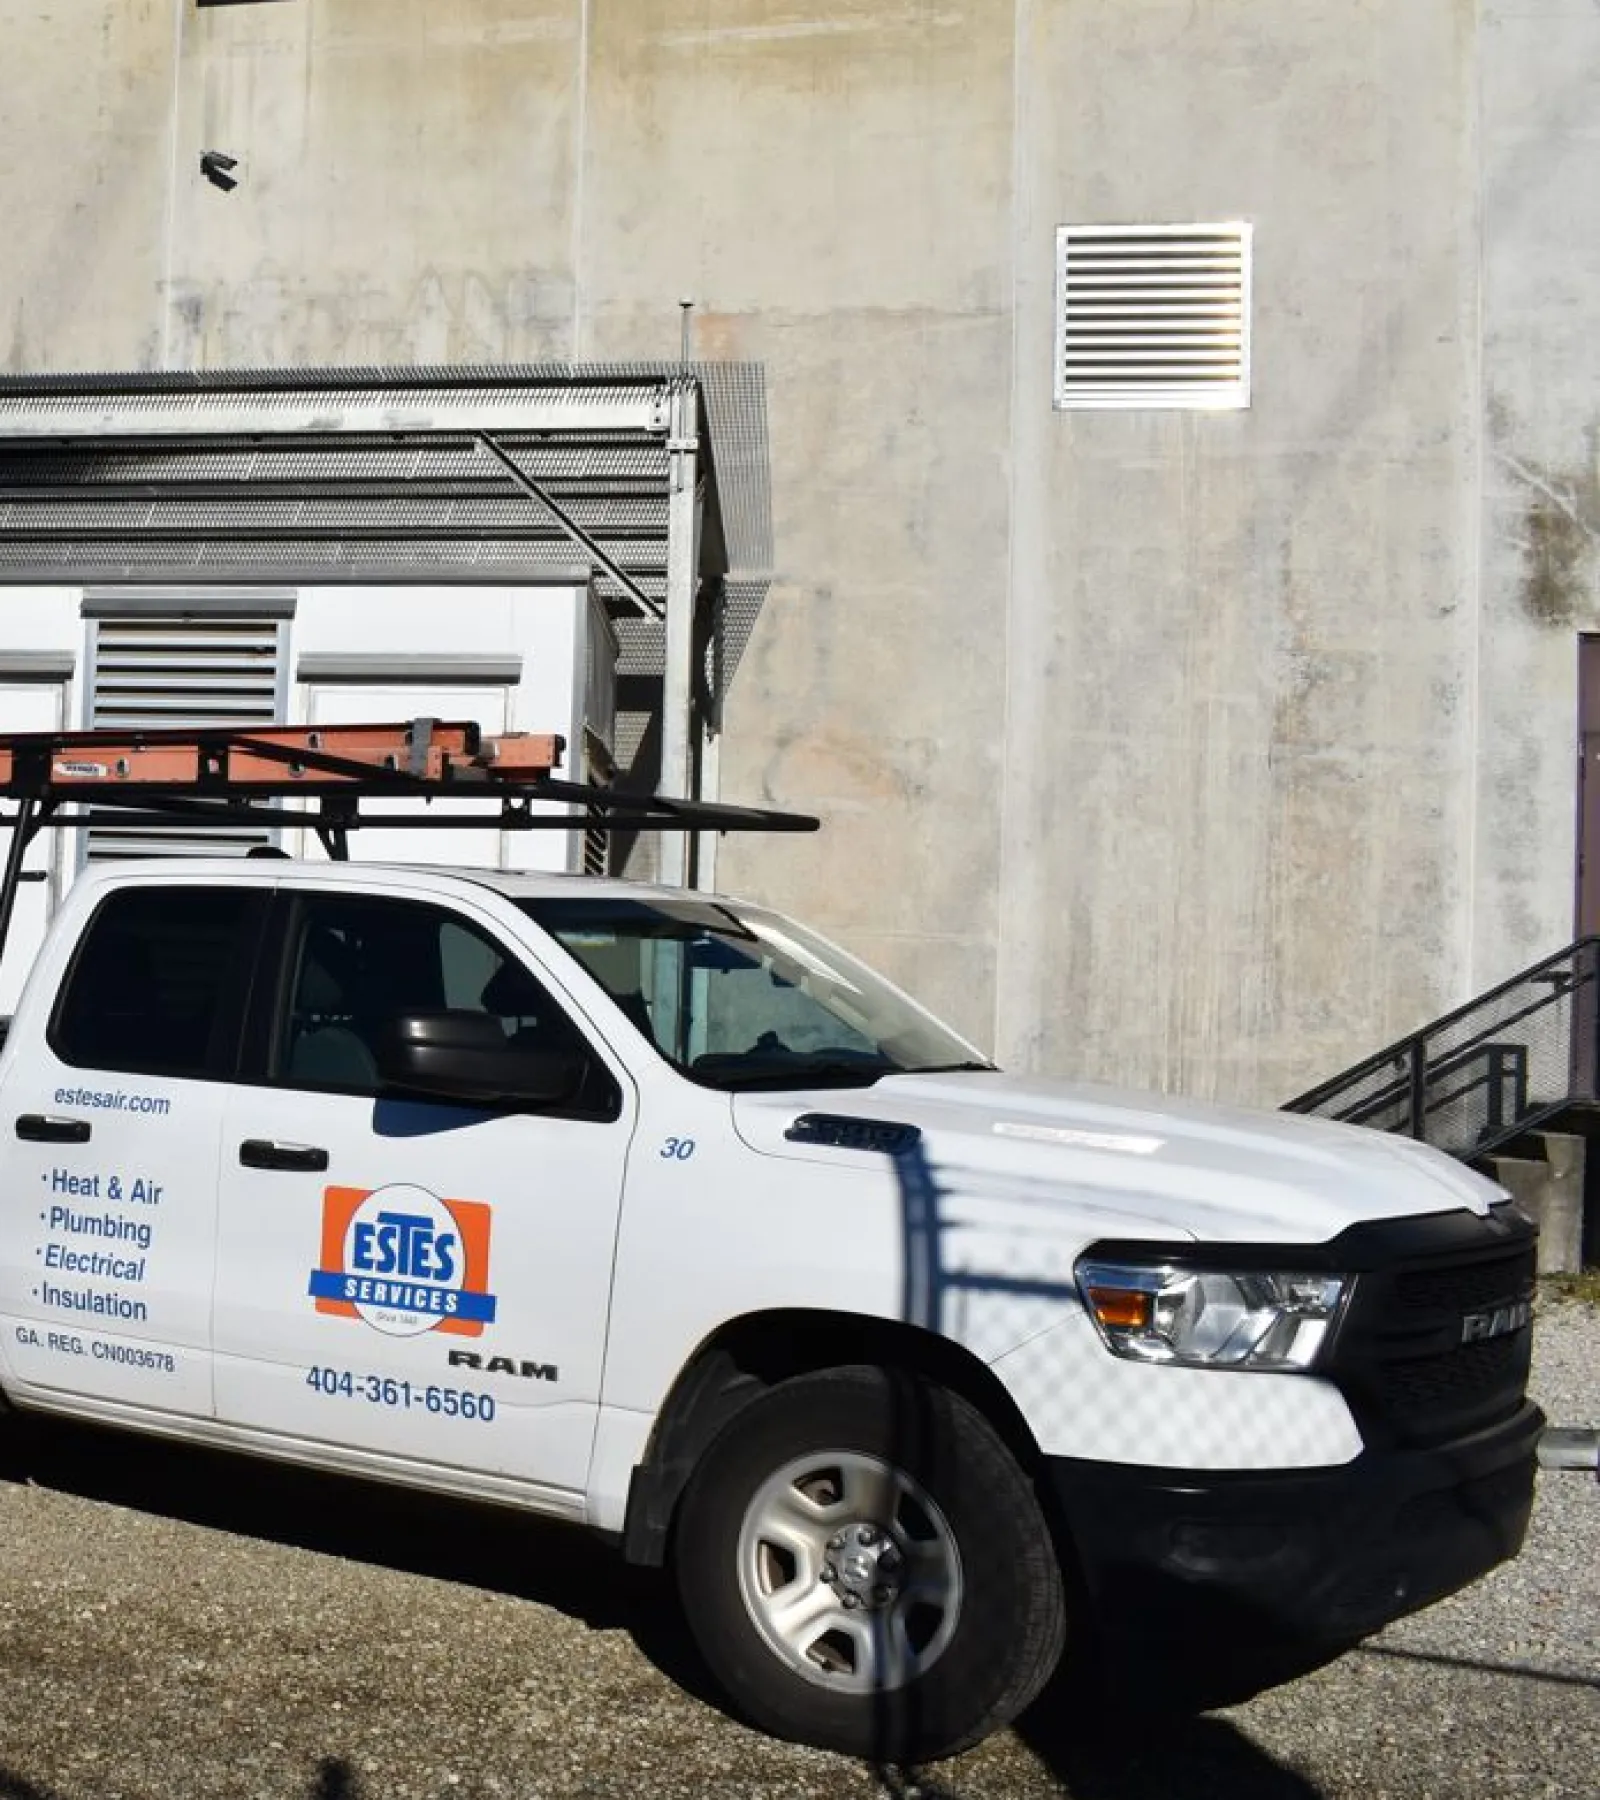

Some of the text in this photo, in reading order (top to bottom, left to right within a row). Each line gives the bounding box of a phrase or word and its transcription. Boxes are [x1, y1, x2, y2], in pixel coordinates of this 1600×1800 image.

[54, 1087, 171, 1115] estesair.com
[660, 1136, 696, 1161] 30
[52, 1168, 164, 1205] Heat & Air
[50, 1205, 152, 1250] Plumbing
[353, 1210, 456, 1282] ESTES
[45, 1243, 146, 1282] Electrical
[43, 1282, 148, 1321] Insulation
[344, 1279, 459, 1313] SERVICES
[15, 1326, 44, 1348] GA.
[48, 1332, 89, 1356] REG.
[448, 1349, 559, 1383] RAM
[306, 1365, 496, 1422] 404-361-6560
